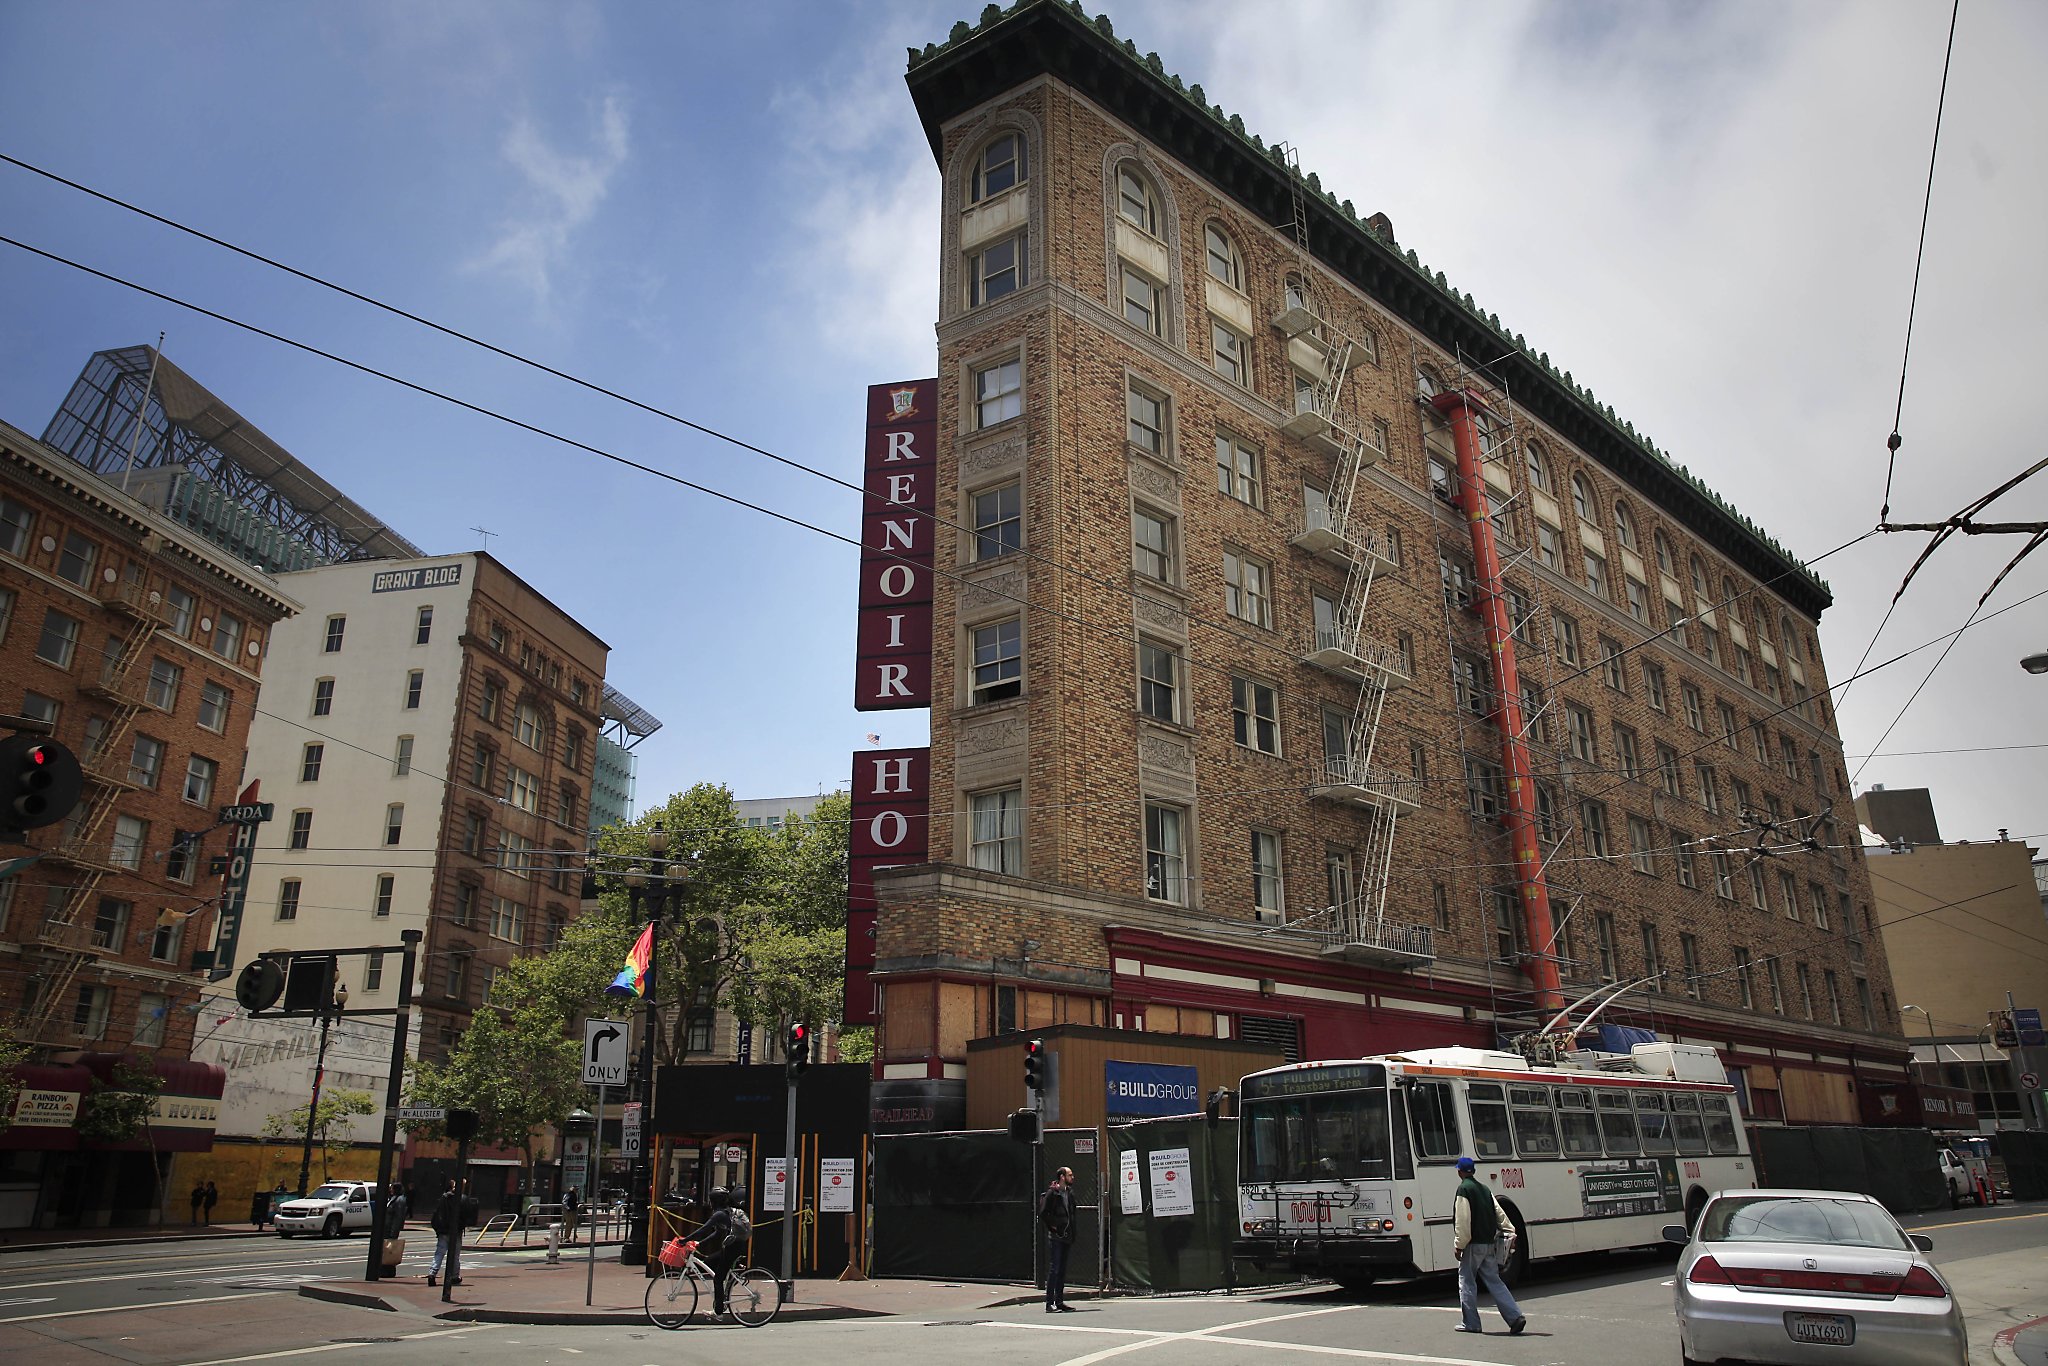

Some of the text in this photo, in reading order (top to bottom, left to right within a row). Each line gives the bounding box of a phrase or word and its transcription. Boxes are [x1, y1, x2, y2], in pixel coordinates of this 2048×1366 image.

[875, 430, 920, 699] RENOIR
[375, 566, 460, 591] GRANT BLDG.
[224, 805, 263, 821] AIDA
[214, 825, 251, 969] HOTEL
[588, 1065, 621, 1080] ONLY
[1283, 1069, 1330, 1084] FULTON
[1338, 1066, 1361, 1079] LTD
[31, 1093, 69, 1102] RAINBOW
[1119, 1081, 1197, 1100] BUILDGROUP
[36, 1102, 60, 1110] PIZZA
[168, 1103, 217, 1121] HOTEL
[1923, 1097, 1975, 1115] RENOIR HOTEL
[412, 1110, 441, 1118] ALLISTER
[871, 1107, 934, 1122] TRAILHEAD
[626, 1139, 639, 1151] 10
[1241, 1185, 1259, 1195] 5620
[1588, 1181, 1615, 1191] UNIVERSITY
[1622, 1180, 1634, 1189] BEST
[1633, 1179, 1644, 1188] CITY
[345, 1206, 362, 1214] POLICE
[1797, 1323, 1845, 1339] 4UIY690
